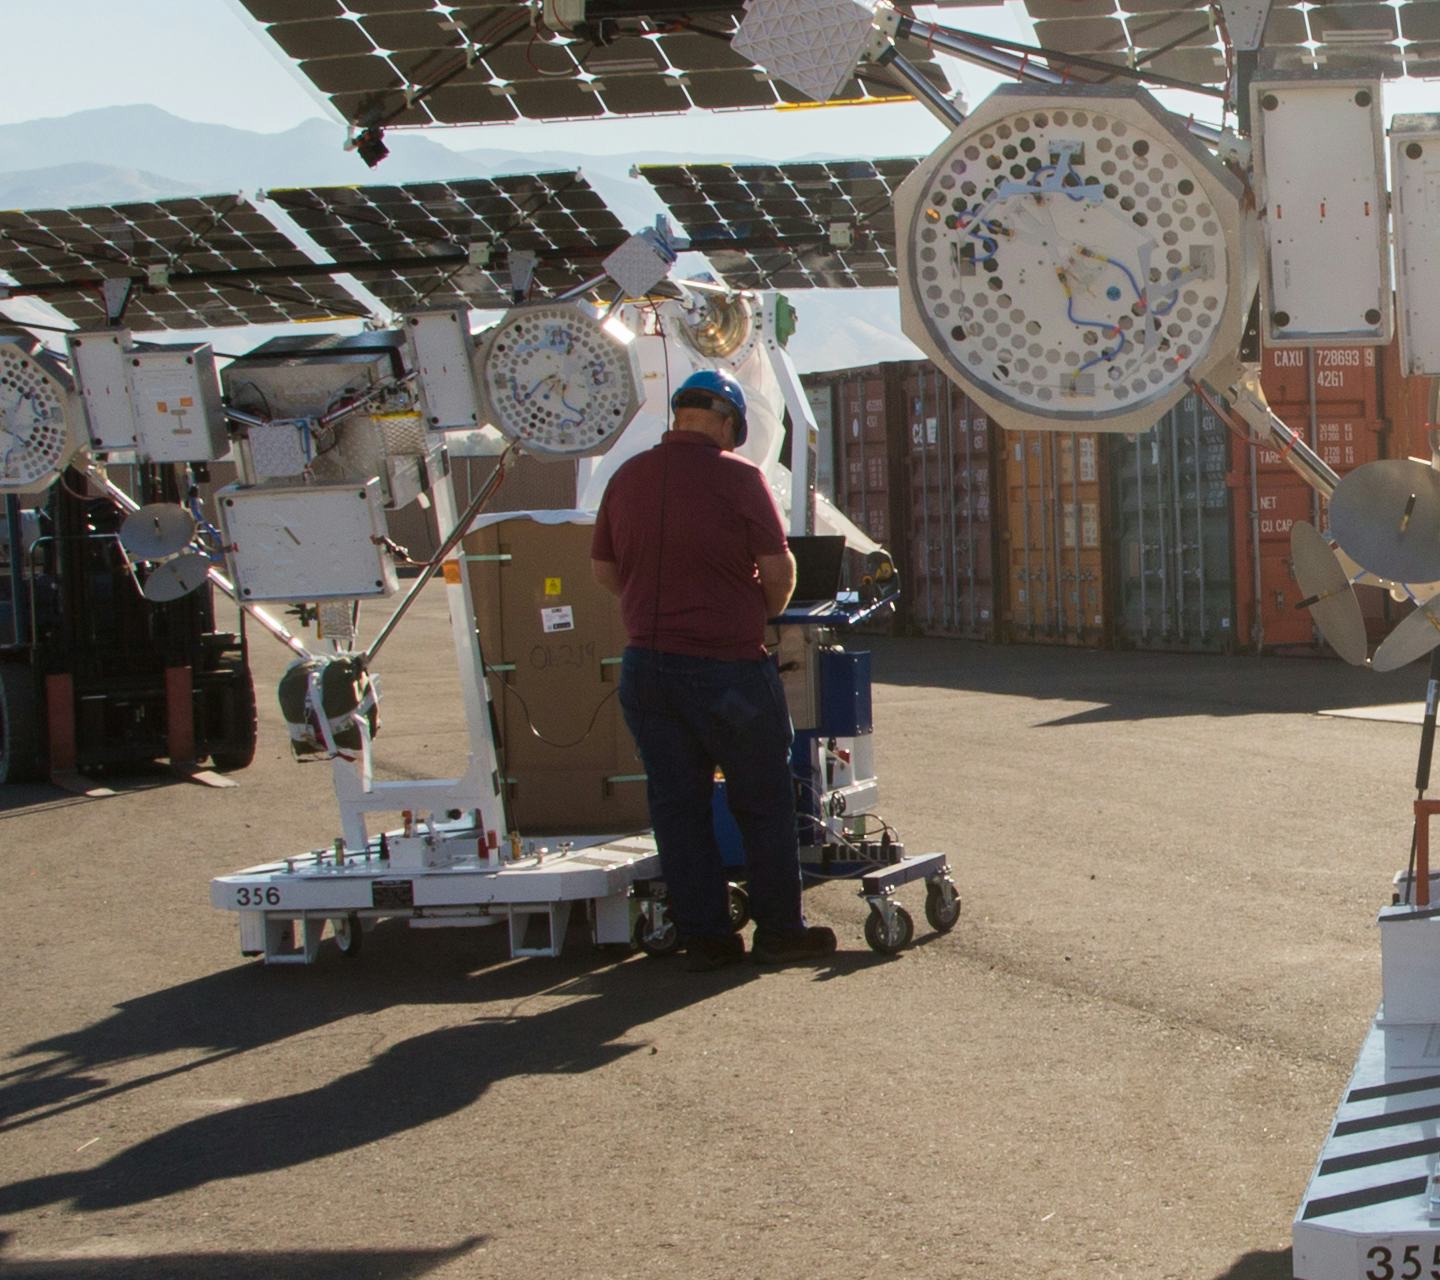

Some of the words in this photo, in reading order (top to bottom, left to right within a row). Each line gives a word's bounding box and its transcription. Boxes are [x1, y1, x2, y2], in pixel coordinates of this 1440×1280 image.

[1274, 350, 1304, 367] CAXU
[1316, 349, 1360, 366] 728693
[1365, 349, 1375, 366] 9
[1317, 370, 1344, 387] 42G1
[1260, 496, 1277, 509] NET
[236, 887, 281, 907] 356
